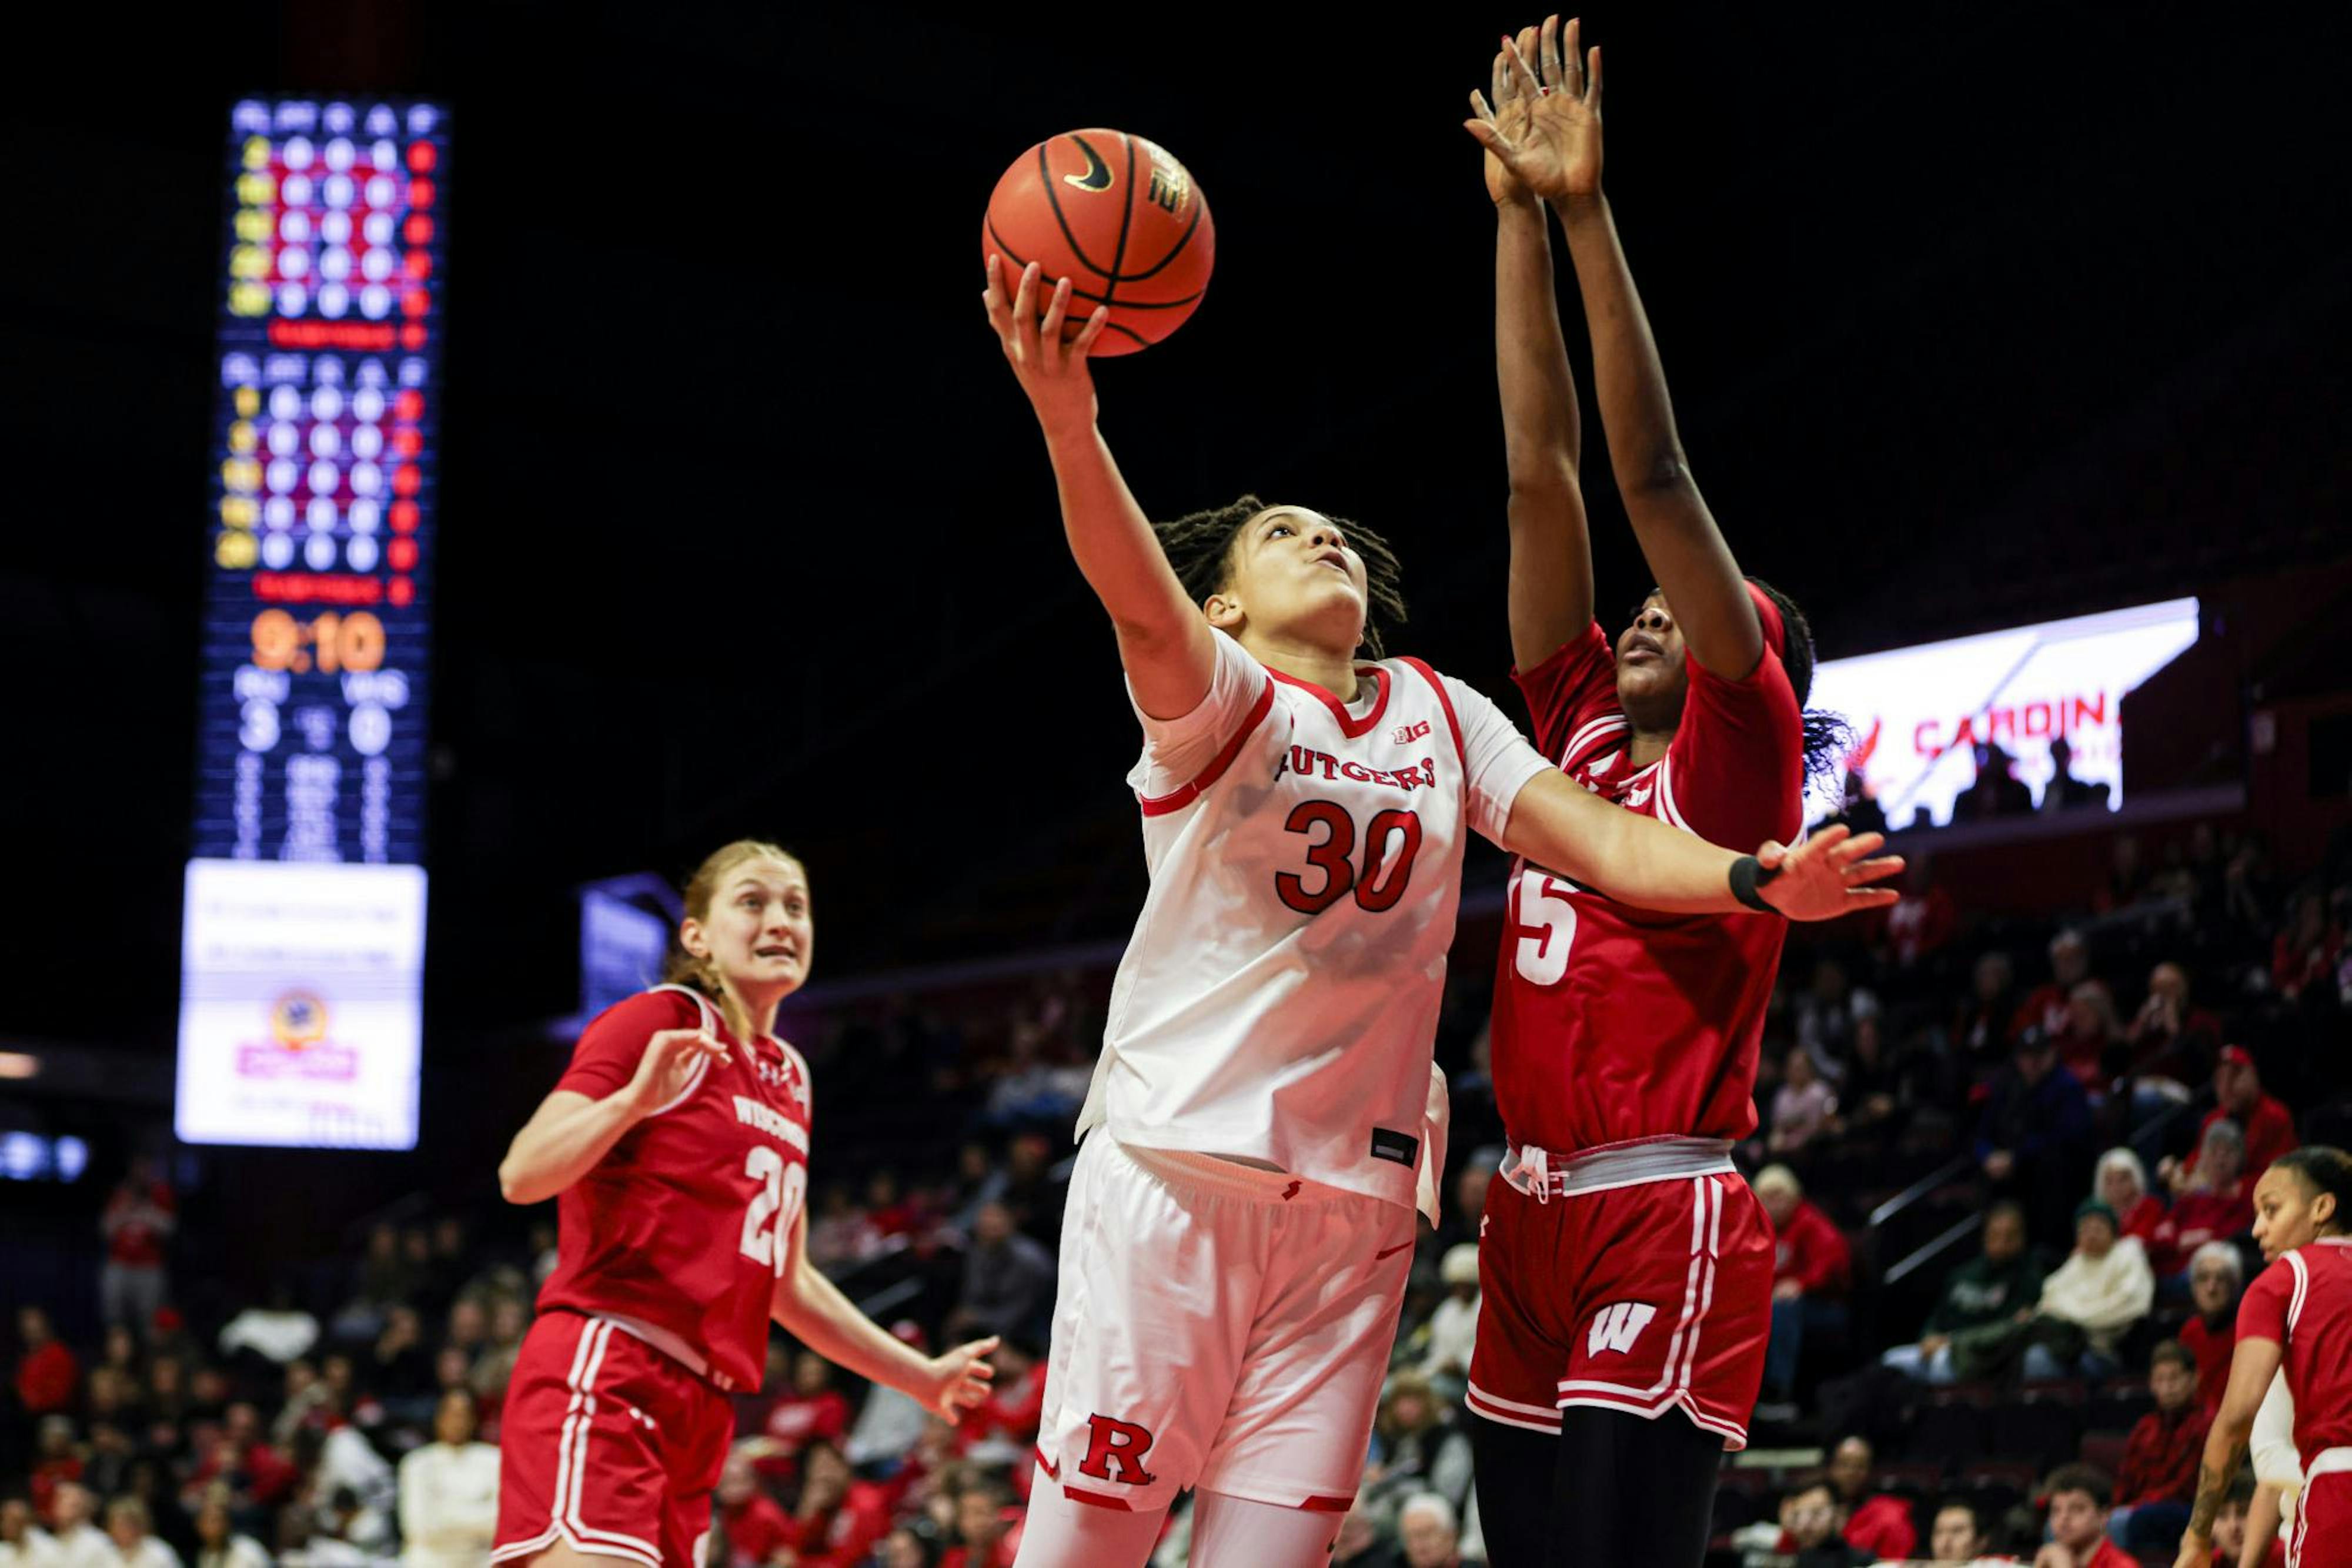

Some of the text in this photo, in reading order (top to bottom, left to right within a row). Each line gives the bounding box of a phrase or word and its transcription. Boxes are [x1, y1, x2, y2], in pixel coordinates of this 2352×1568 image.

[1274, 745, 1435, 791] UTGERS
[1275, 799, 1422, 915] 30
[1507, 869, 1581, 986] 5
[740, 1146, 808, 1278] 20
[1588, 1302, 1657, 1359] W
[1079, 1413, 1154, 1486] R
